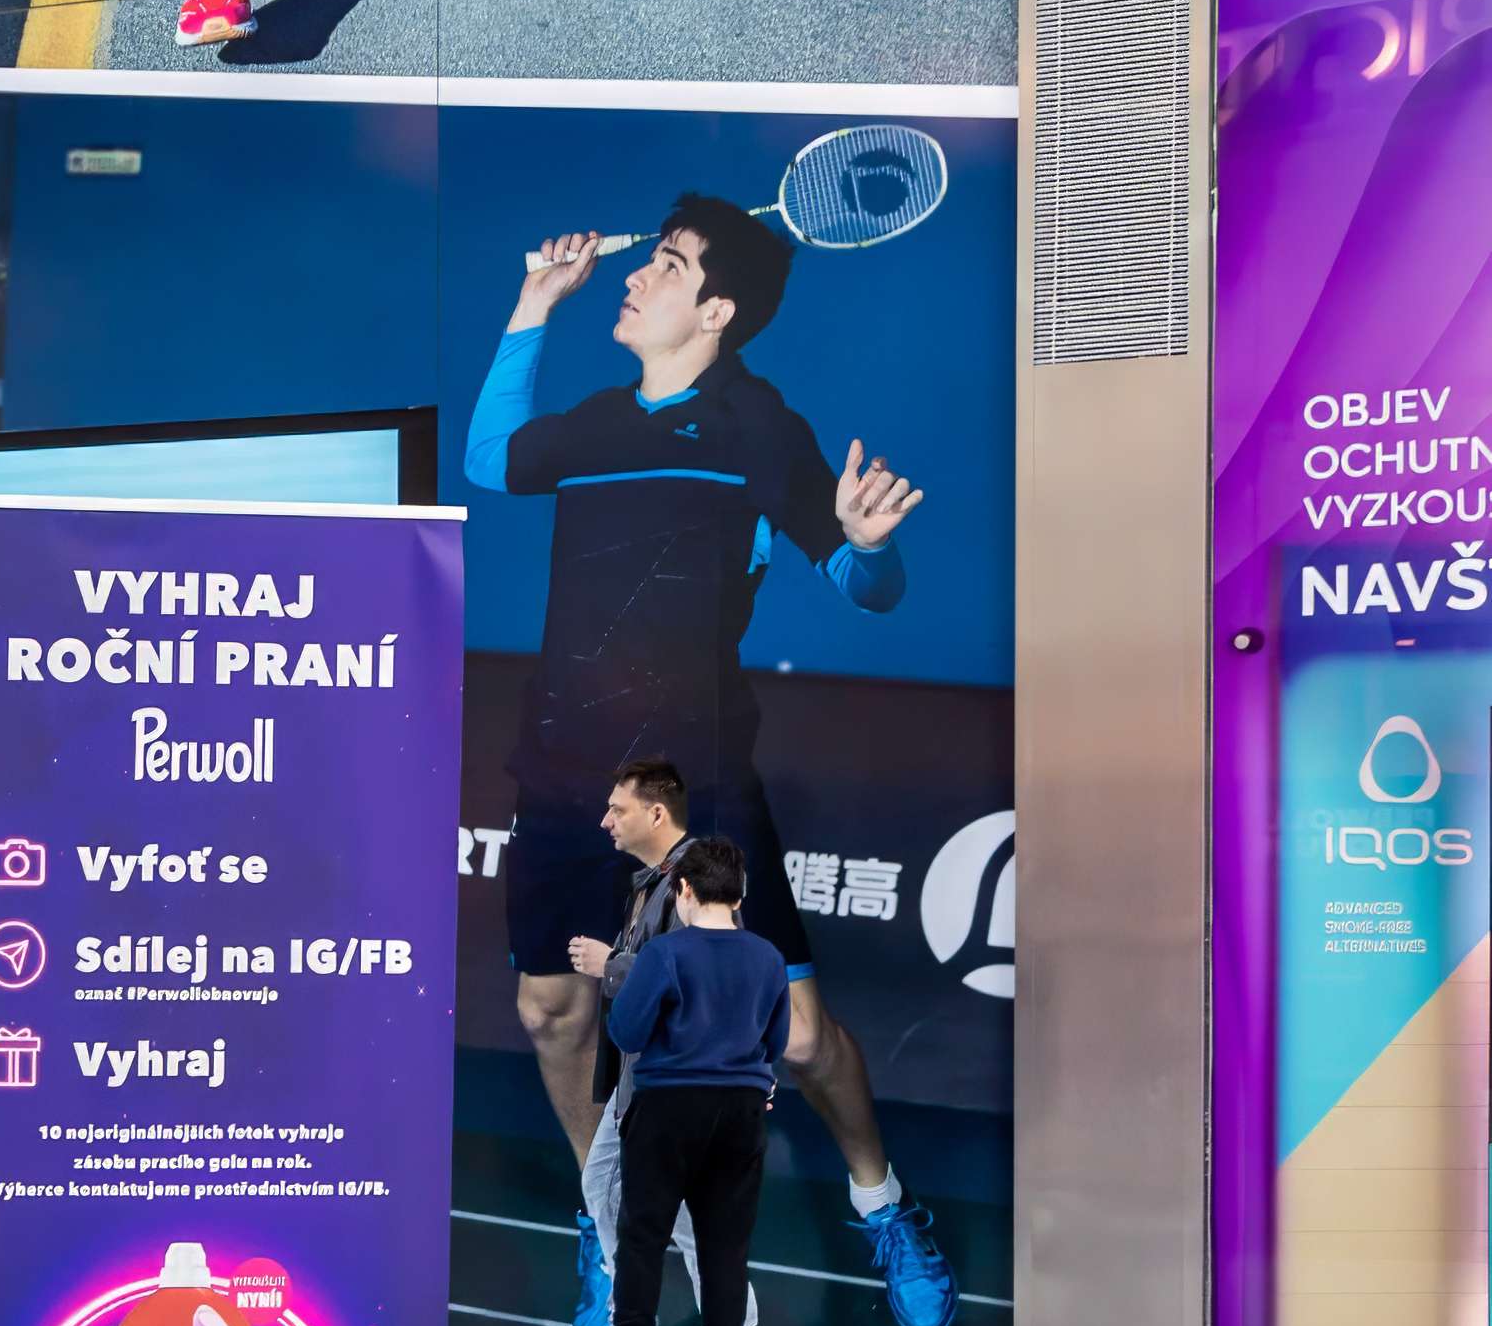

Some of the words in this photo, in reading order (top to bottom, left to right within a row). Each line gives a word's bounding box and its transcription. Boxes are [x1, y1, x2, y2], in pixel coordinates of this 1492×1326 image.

[1303, 386, 1451, 430] OBJEV
[1303, 436, 1492, 480] OCHUTN
[1302, 487, 1492, 530] VYZKOU
[73, 570, 315, 619] VYHRAJ
[1301, 540, 1492, 617] NAVŠ
[7, 628, 199, 684] ROČNÍ
[216, 634, 399, 688] PRANÍ
[131, 706, 275, 783] Perwoll
[76, 844, 213, 892] Vyfoť
[219, 854, 268, 884] se
[1325, 827, 1474, 871] IQOS
[1324, 902, 1403, 915] ADVANCED
[74, 934, 208, 984] Sdílej
[222, 945, 275, 973] na
[289, 937, 413, 976] IG/FB
[1324, 939, 1427, 953] ALTERNATIVES
[74, 986, 123, 1001] označ
[73, 1038, 226, 1088] Vyhraj
[38, 1125, 62, 1140] 10
[227, 1123, 275, 1140] fotek
[73, 1154, 136, 1170] zásobu
[251, 1157, 273, 1169] na
[276, 1153, 313, 1169] rok.
